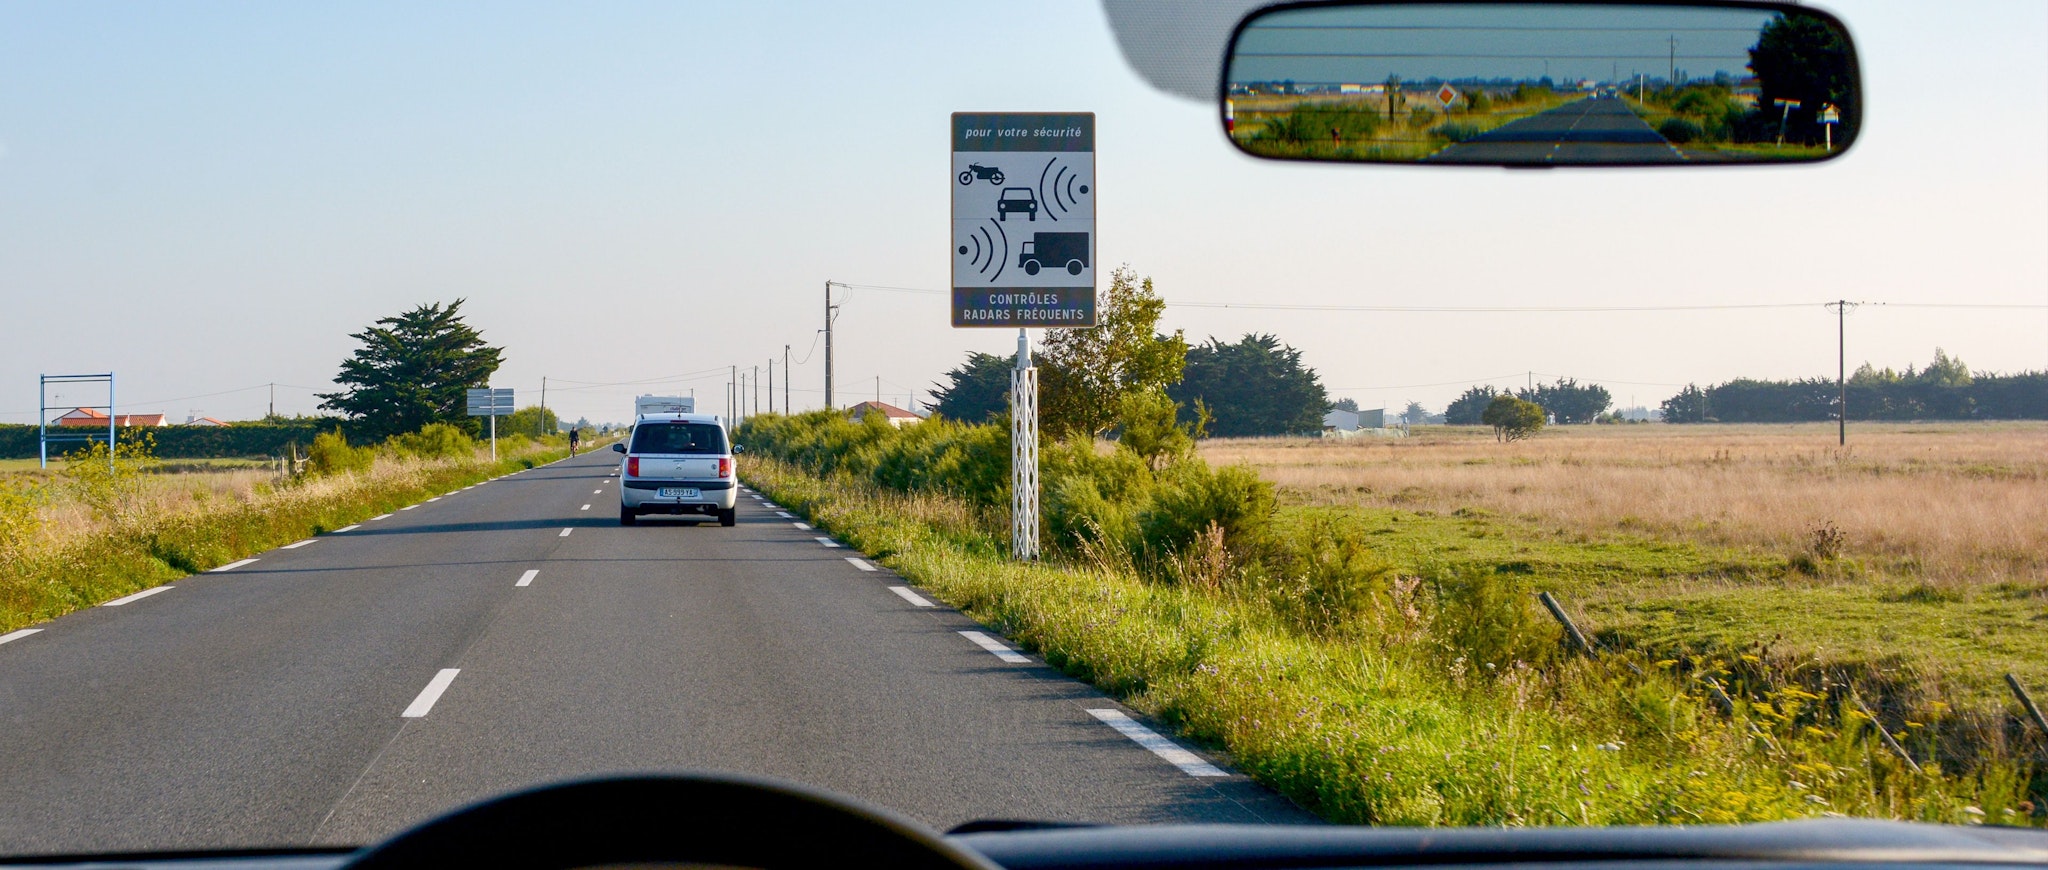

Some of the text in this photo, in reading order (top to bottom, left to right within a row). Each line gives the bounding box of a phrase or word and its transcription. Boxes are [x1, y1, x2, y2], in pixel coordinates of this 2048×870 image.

[965, 126, 1082, 139] pour votre sécurité
[989, 292, 1058, 305] CONTRÔLES
[963, 306, 1084, 320] RADARS FRÉQUENTS
